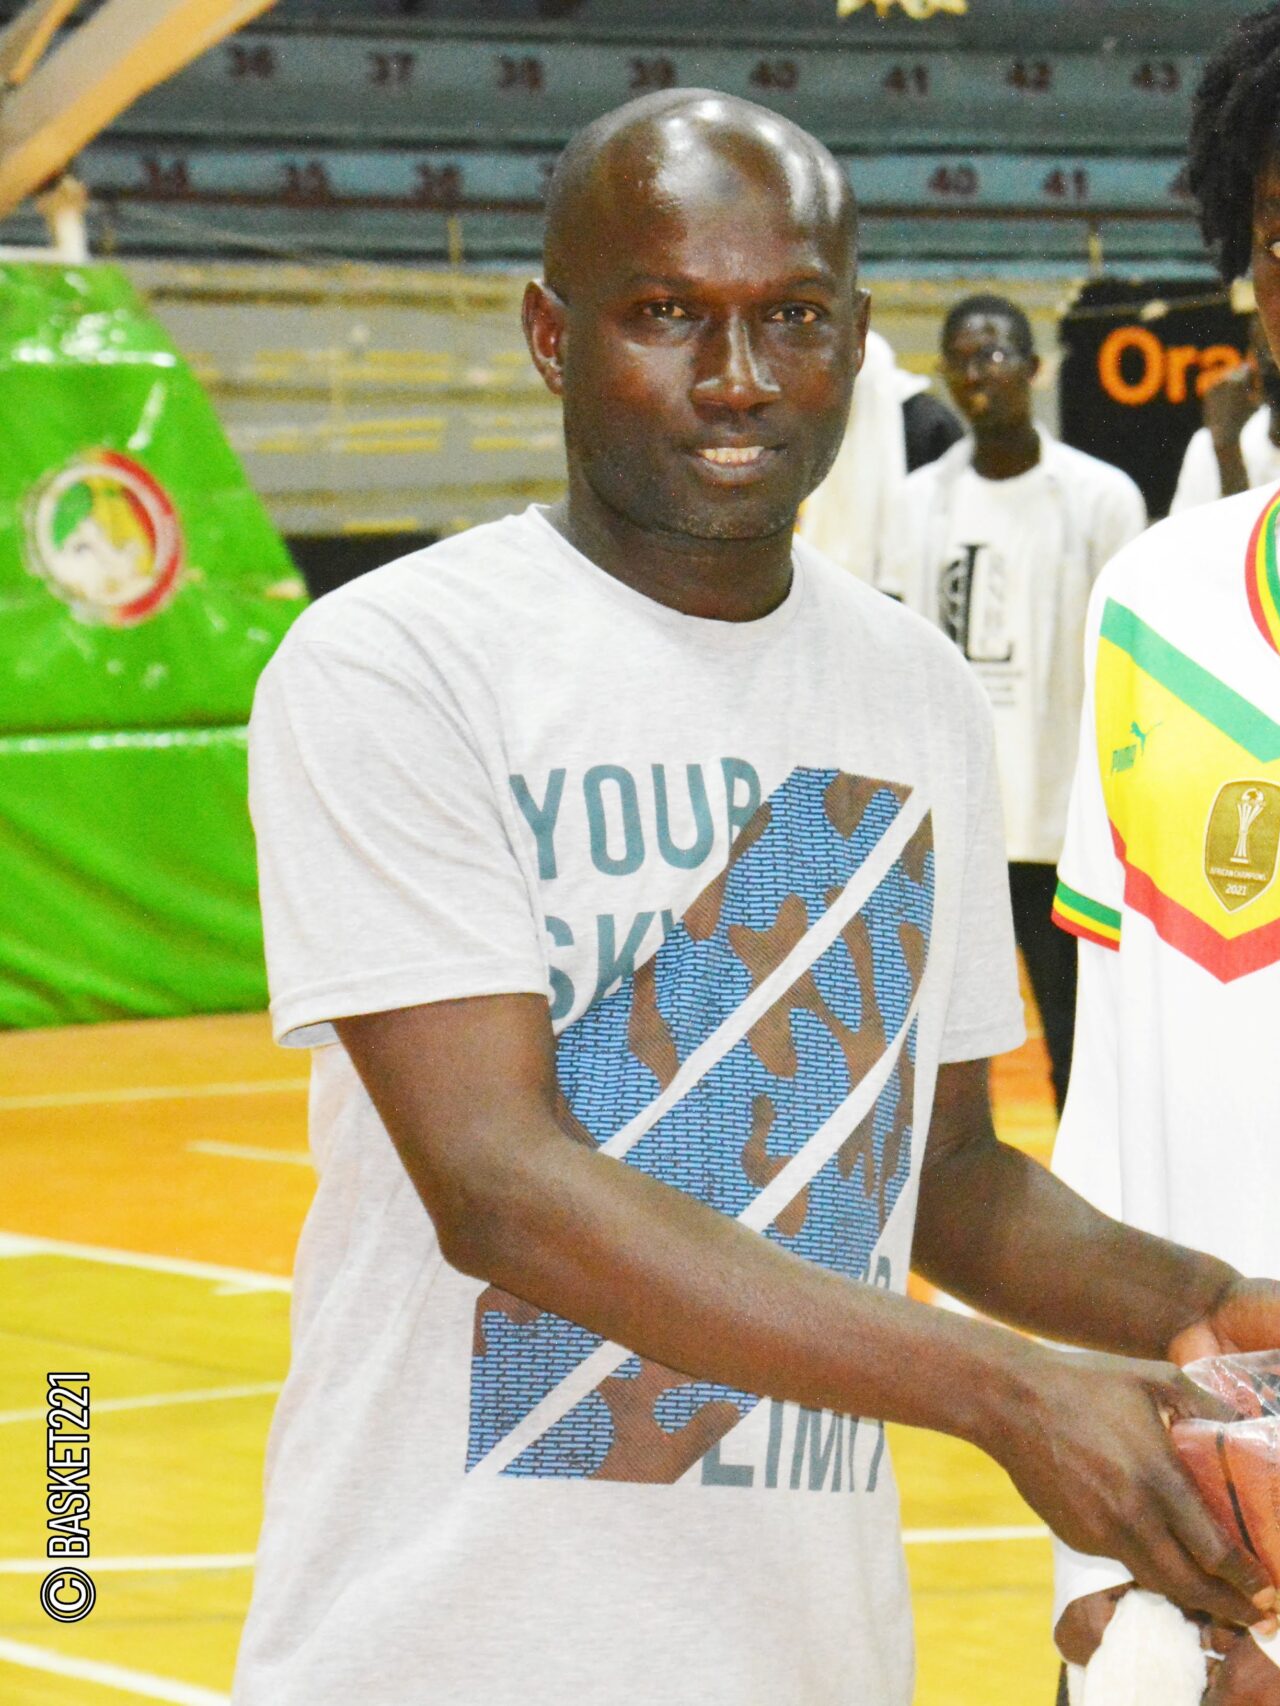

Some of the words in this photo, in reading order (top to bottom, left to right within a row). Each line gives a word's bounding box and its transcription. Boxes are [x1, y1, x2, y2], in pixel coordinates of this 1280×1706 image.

[883, 63, 930, 96] 41
[1131, 61, 1180, 93] 43
[928, 164, 979, 196] 40
[1043, 166, 1089, 200] 41
[1098, 325, 1258, 406] Ora
